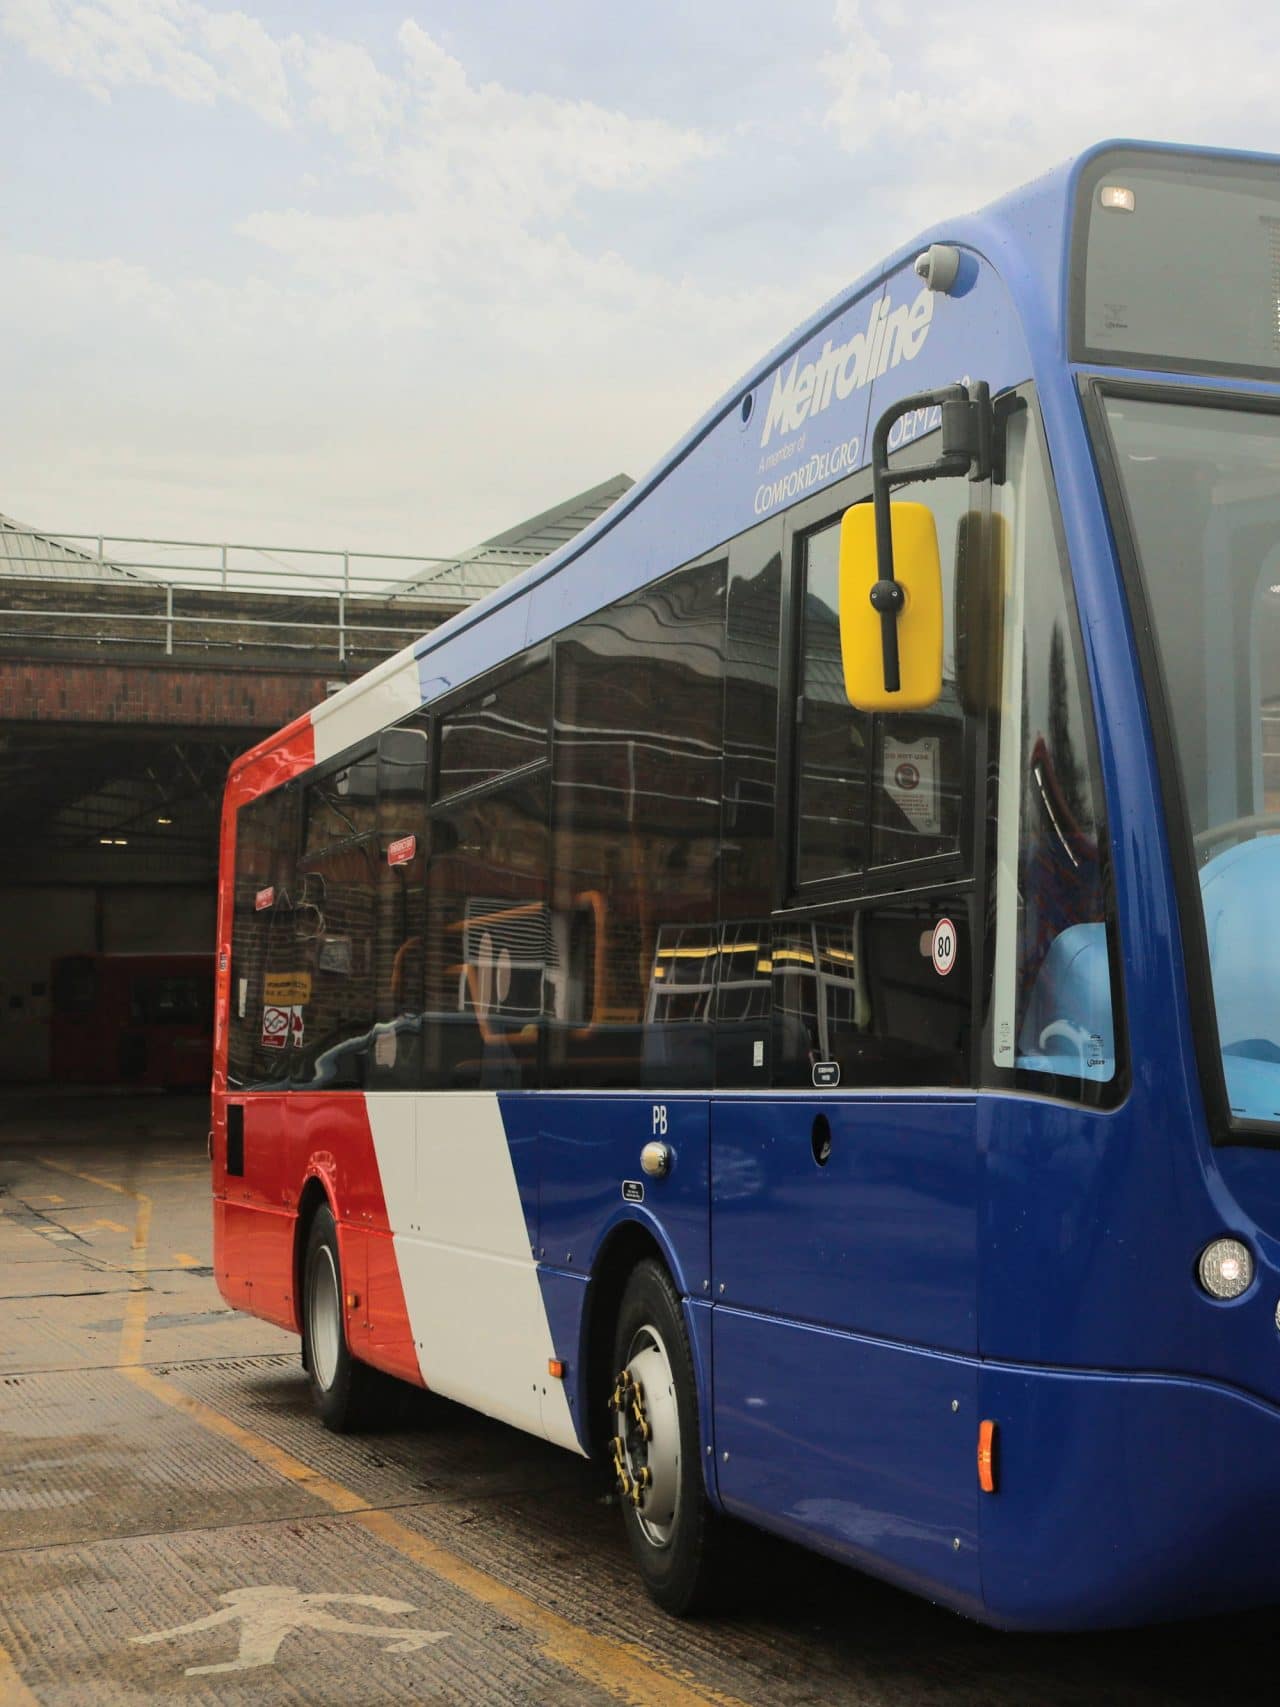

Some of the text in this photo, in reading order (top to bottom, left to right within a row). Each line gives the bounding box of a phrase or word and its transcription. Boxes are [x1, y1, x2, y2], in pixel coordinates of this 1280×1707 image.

[760, 287, 936, 449] Metroline
[938, 936, 951, 957] 80
[652, 1105, 668, 1134] PB
